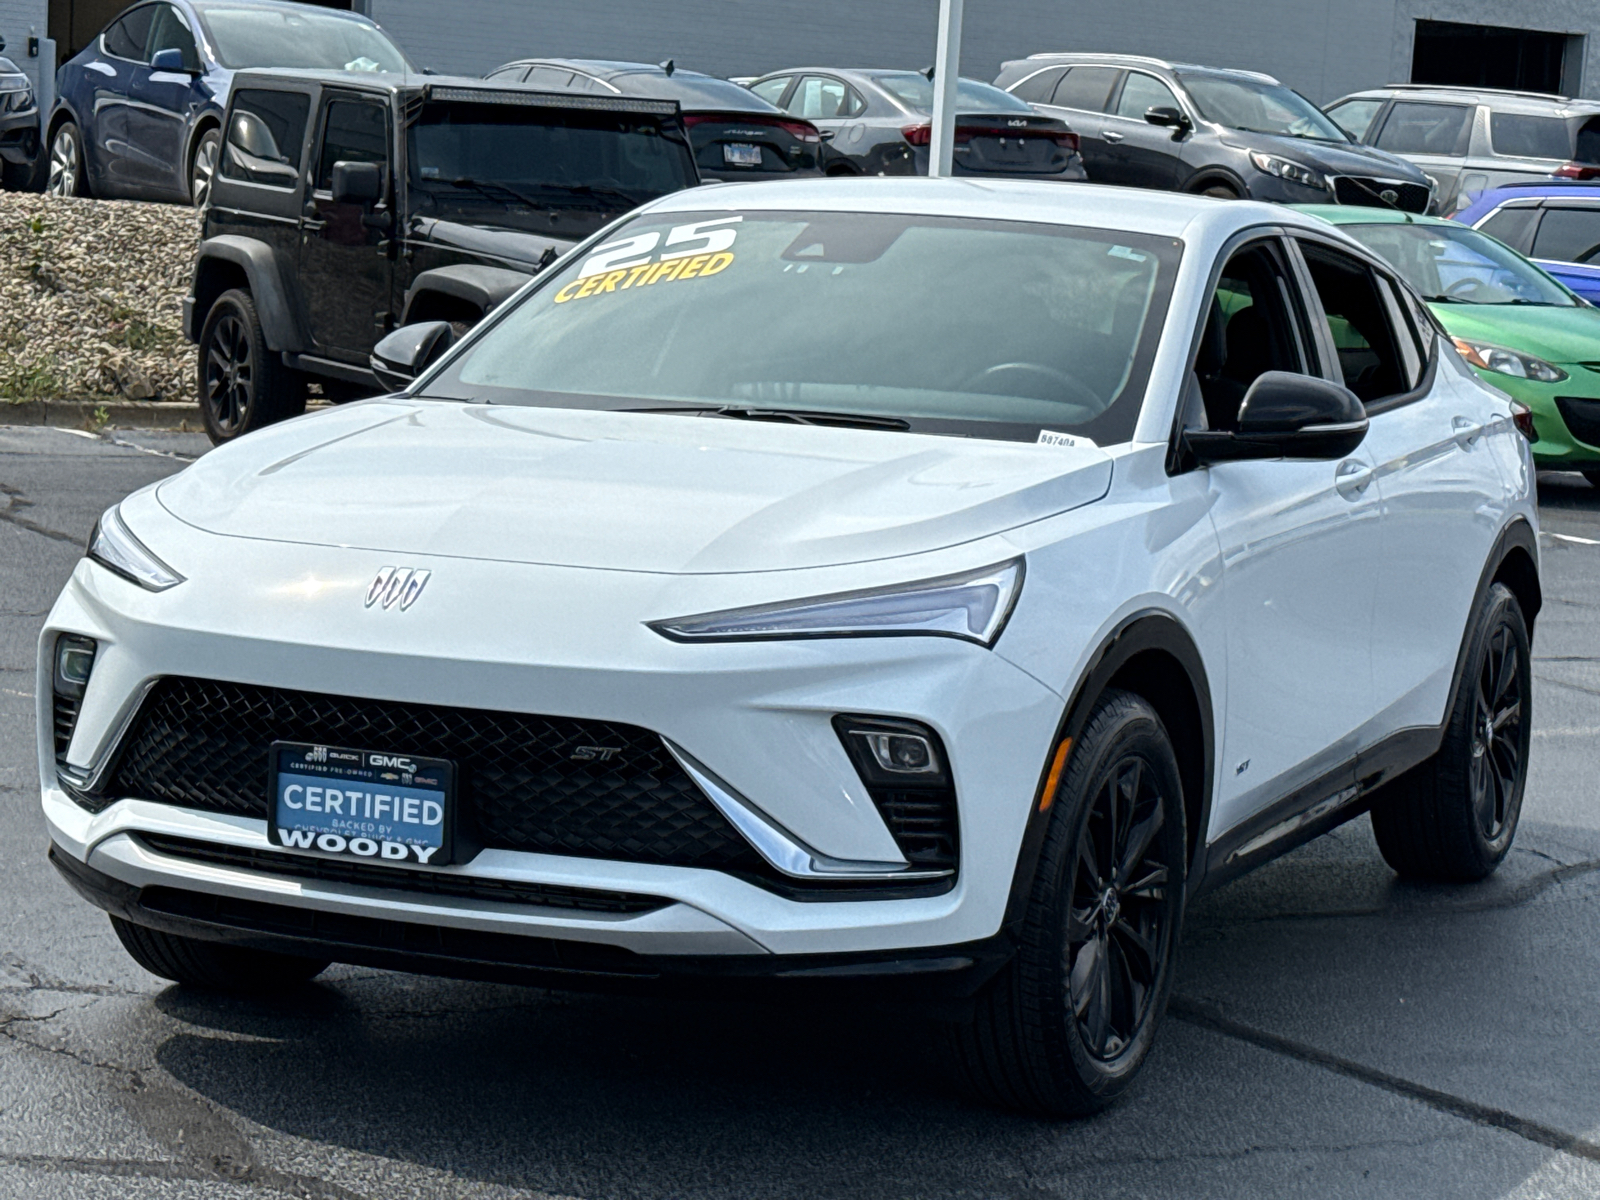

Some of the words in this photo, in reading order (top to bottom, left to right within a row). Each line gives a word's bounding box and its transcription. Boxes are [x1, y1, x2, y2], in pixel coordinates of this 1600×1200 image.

[577, 215, 743, 279] 25
[553, 252, 734, 304] CERTIFIED
[329, 752, 359, 761] BUICK
[369, 754, 411, 769] GMC
[570, 745, 622, 761] ST
[290, 761, 328, 772] CERTIFIED
[283, 784, 443, 826] CERTIFIED
[331, 818, 375, 833] BACKED
[378, 824, 392, 834] BY
[277, 828, 439, 864] WOODY
